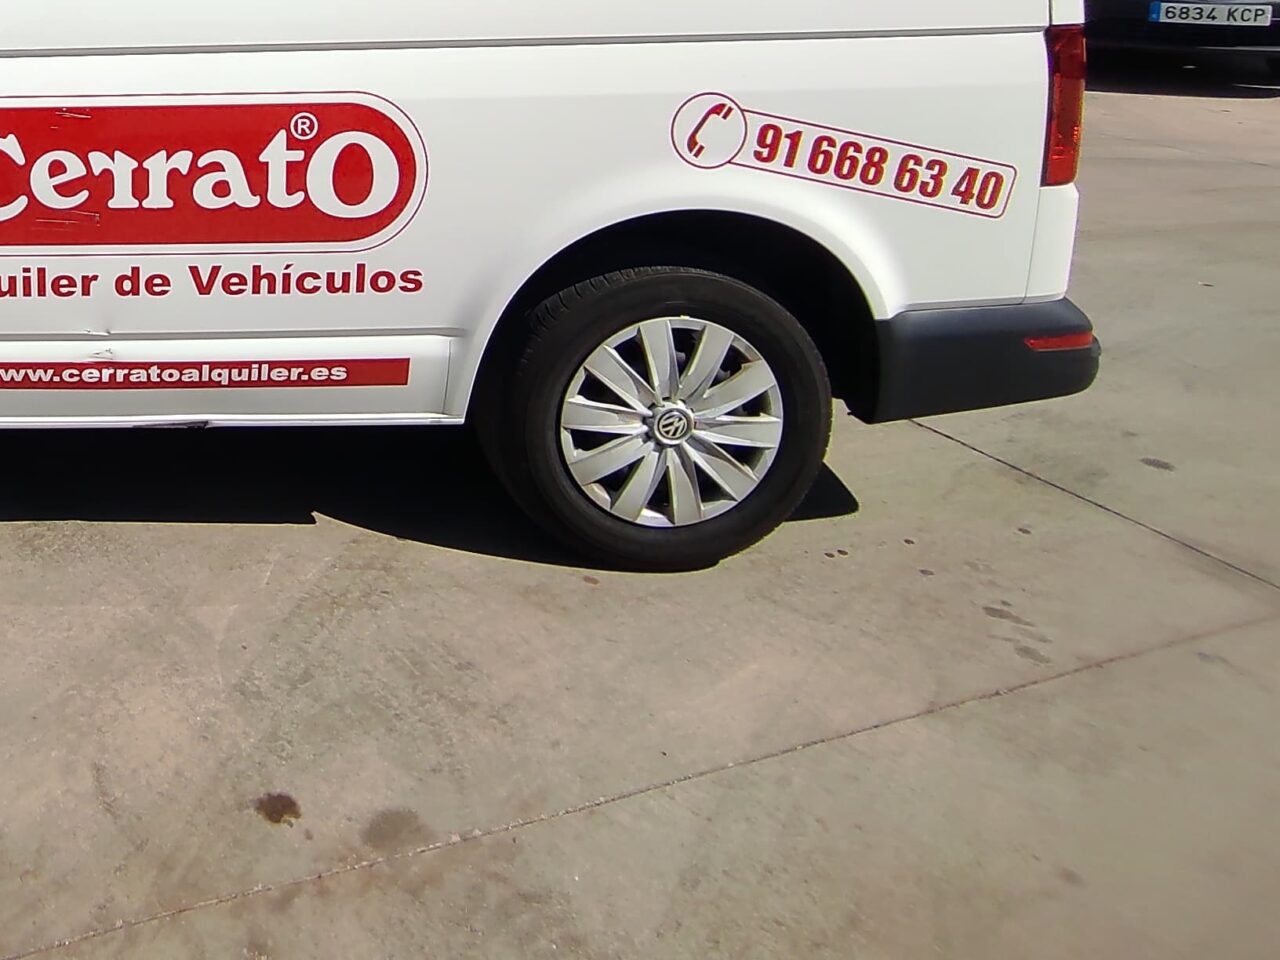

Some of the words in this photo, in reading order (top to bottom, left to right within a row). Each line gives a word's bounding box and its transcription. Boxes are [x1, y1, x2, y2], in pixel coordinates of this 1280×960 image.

[1165, 6, 1218, 21] 6834
[1226, 7, 1266, 23] KCP
[753, 123, 803, 168] 91
[807, 135, 889, 186] 668
[893, 153, 948, 199] 63
[951, 166, 1005, 210] 40
[114, 265, 171, 297] de
[188, 262, 424, 296] Vehículos
